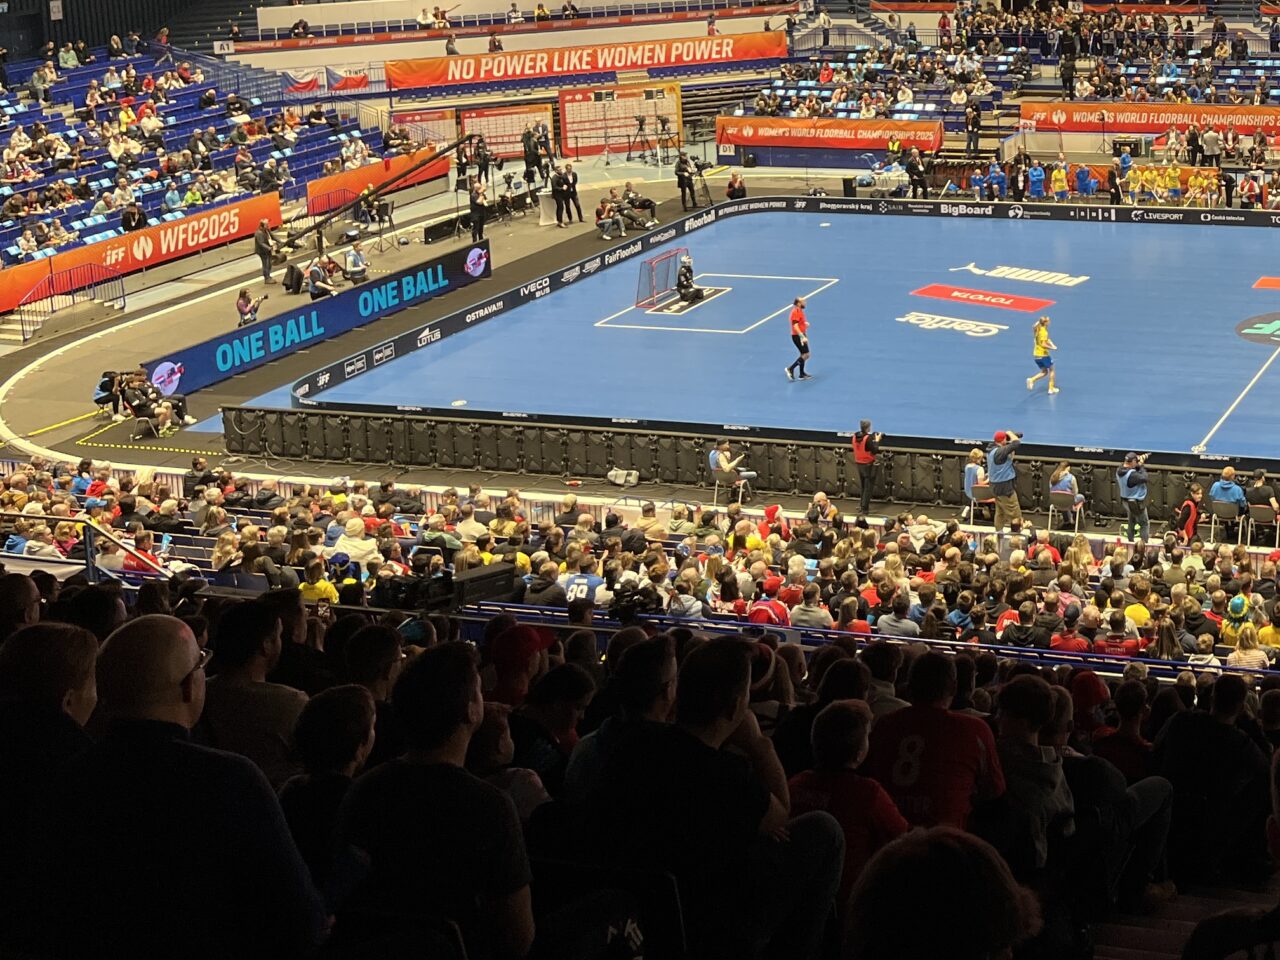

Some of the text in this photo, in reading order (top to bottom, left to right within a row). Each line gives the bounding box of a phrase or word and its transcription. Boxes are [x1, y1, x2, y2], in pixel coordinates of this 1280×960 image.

[219, 42, 230, 52] A1
[448, 38, 734, 81] NO POWER LIKE WOMEN POWER
[1116, 112, 1147, 124] WORLD
[1149, 113, 1197, 125] FLOORBALL
[1201, 114, 1275, 127] CHAMPIONSHIPS
[758, 126, 789, 138] WOMEN'S
[790, 127, 814, 138] WORLD
[815, 128, 856, 139] FLOORBALL
[857, 129, 915, 141] CHAMPIONSHIPS
[915, 130, 934, 141] 2025
[721, 145, 733, 154] D1
[738, 202, 749, 211] LIKE
[769, 201, 787, 209] POWER
[940, 204, 994, 217] BigBoard
[1143, 212, 1184, 221] LIVESPORT
[160, 208, 240, 255] WFC2025
[604, 241, 642, 266] FairFloorball
[359, 264, 449, 318] ONE BALL
[520, 277, 550, 297] IVECO
[535, 286, 551, 298] BUS
[951, 290, 1014, 305] TOYOTA
[465, 300, 504, 323] OSTRAVA!!!
[895, 311, 1009, 337] Gerflor
[215, 311, 325, 372] ONE BALL
[417, 328, 441, 348] LOTUS
[891, 734, 926, 786] 8
